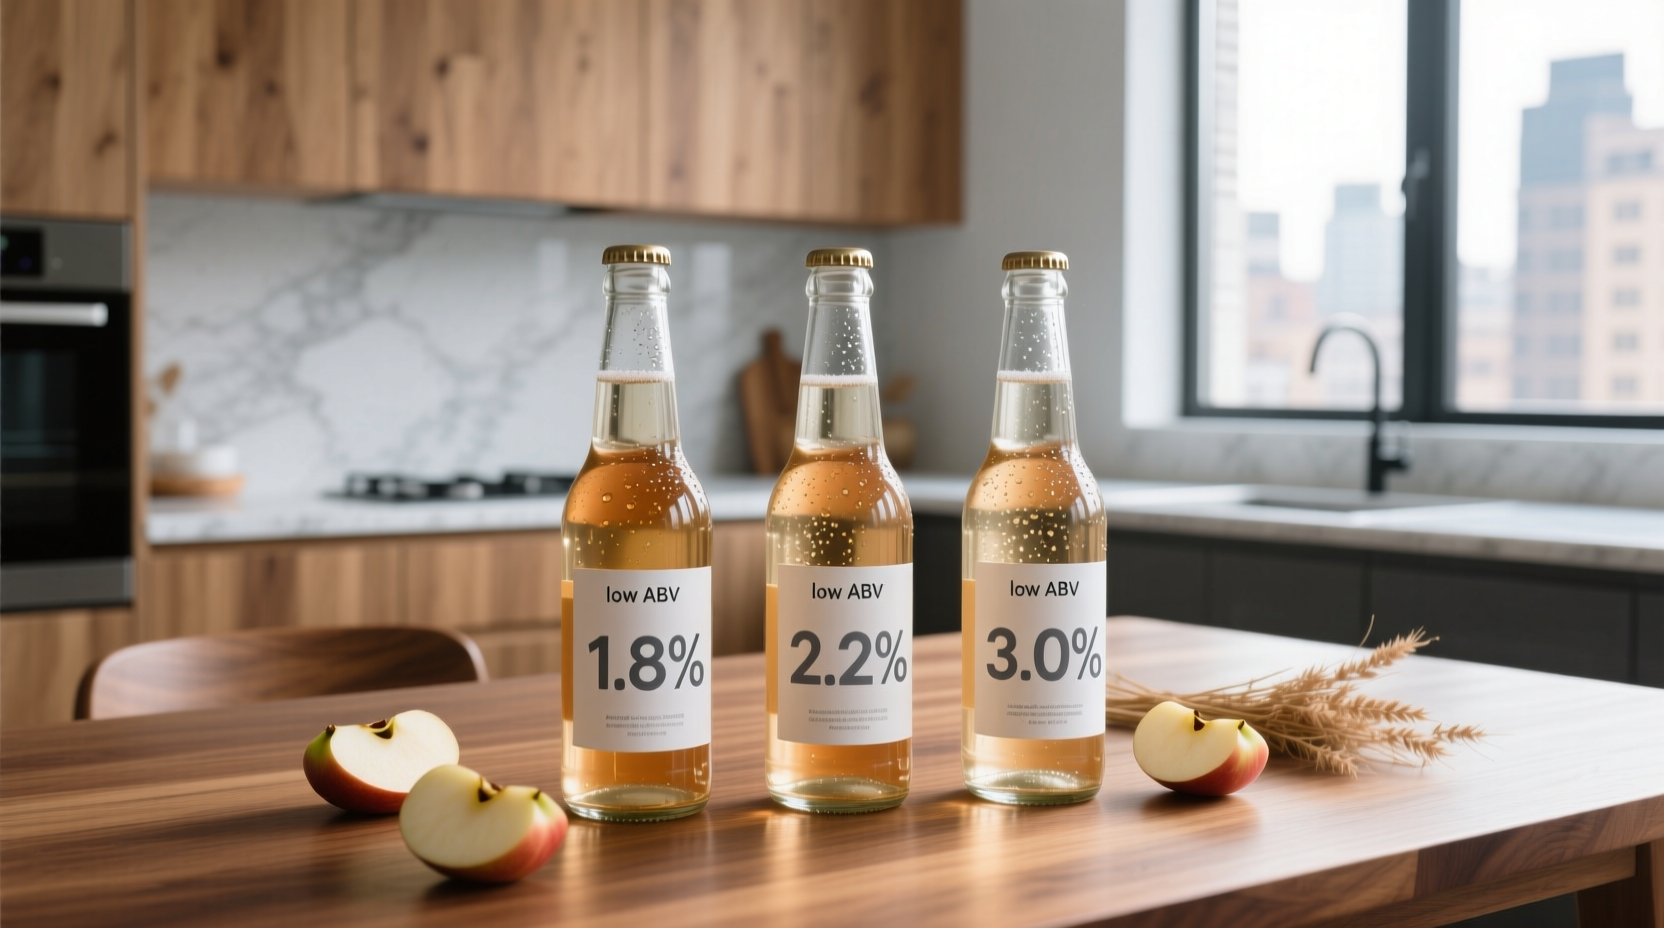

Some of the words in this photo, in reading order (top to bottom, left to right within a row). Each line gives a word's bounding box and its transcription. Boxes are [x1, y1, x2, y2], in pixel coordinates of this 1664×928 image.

[606, 586, 638, 603] low
[643, 586, 681, 603] ABV
[812, 582, 843, 600] low
[847, 583, 884, 600] ABV
[1010, 580, 1041, 597] low
[1045, 581, 1080, 597] ABV
[588, 633, 704, 691] 1.8%
[790, 630, 908, 686] 2.2%
[986, 626, 1102, 682] 3.0%
